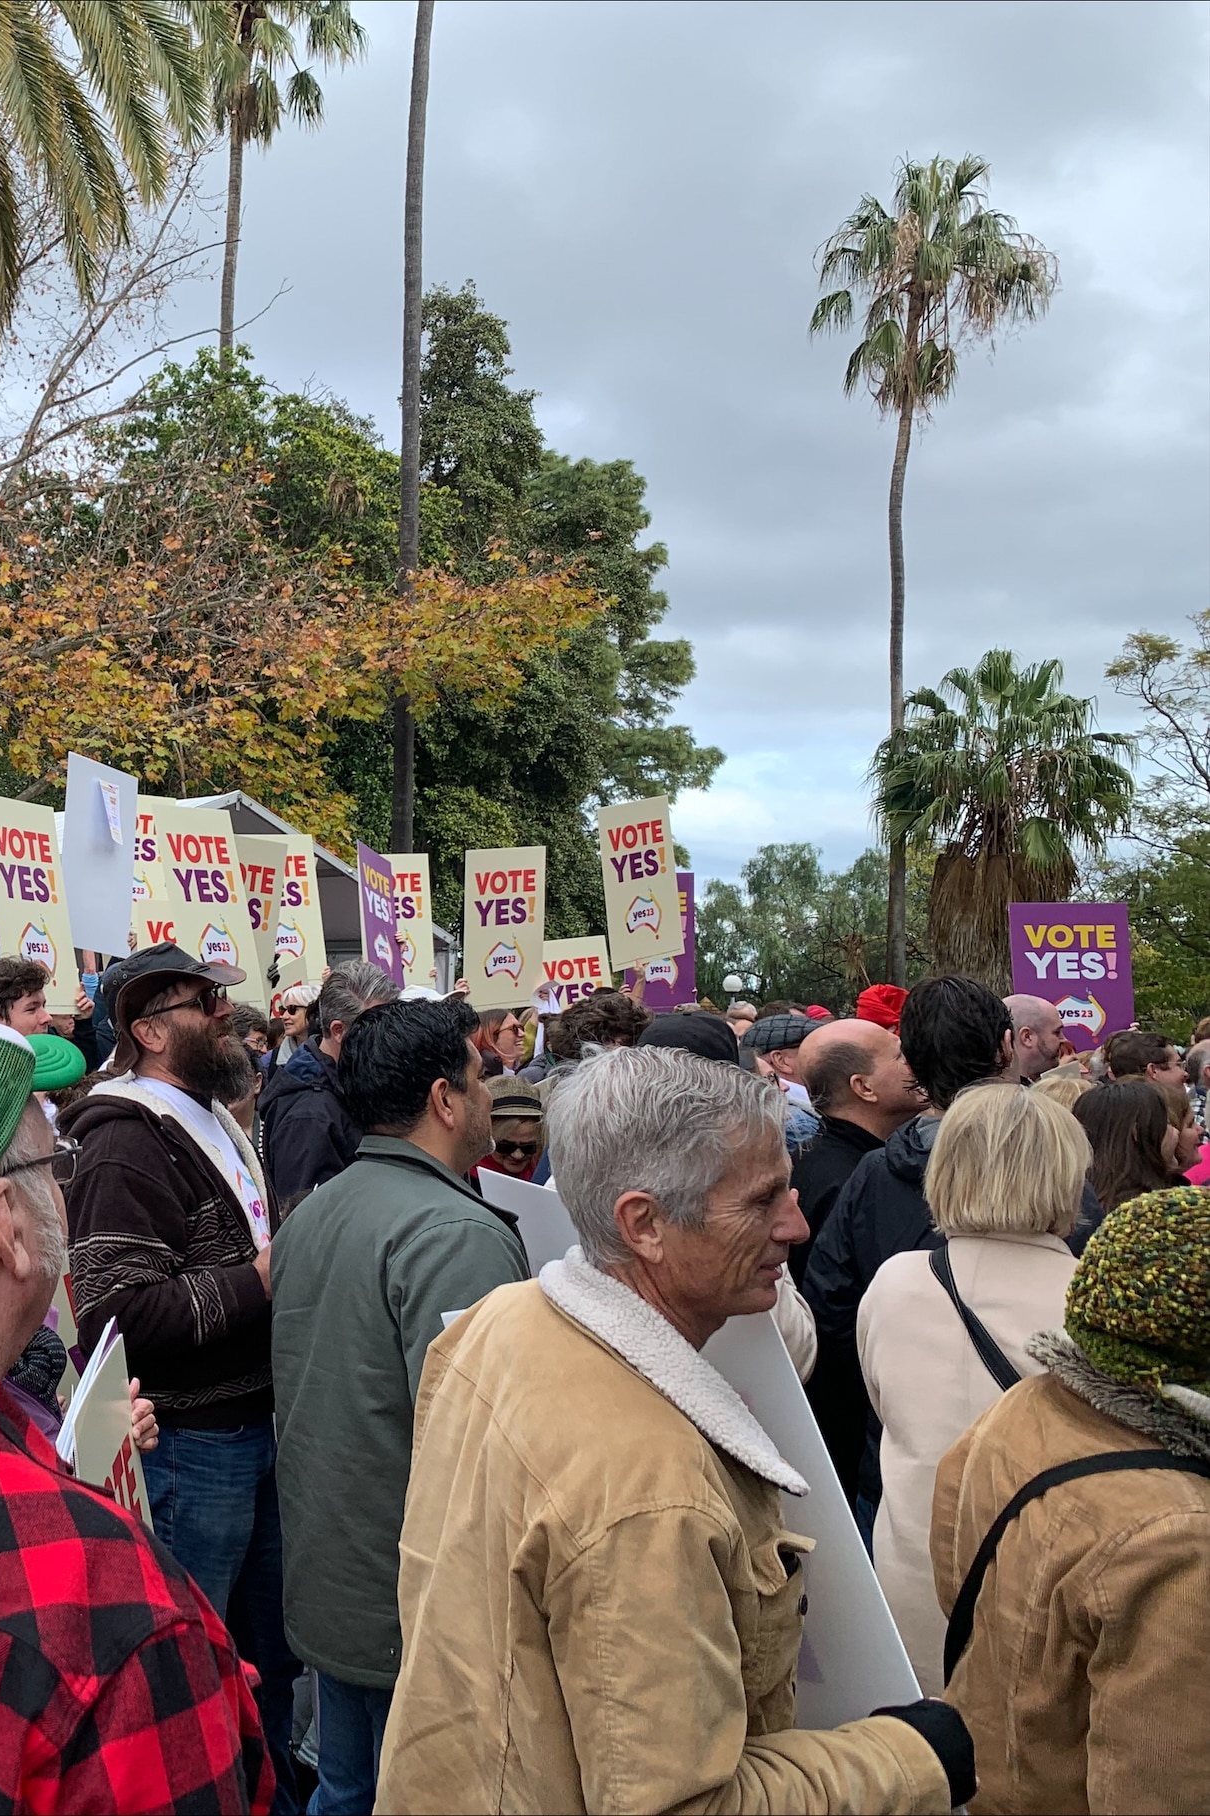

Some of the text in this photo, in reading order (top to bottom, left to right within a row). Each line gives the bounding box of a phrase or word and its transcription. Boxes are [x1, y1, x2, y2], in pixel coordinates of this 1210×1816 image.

[607, 819, 664, 851] VOTE
[166, 833, 230, 865] VOTE
[284, 855, 308, 877] TE
[610, 847, 667, 883] YES!
[132, 887, 145, 895] s23
[172, 869, 238, 904] YES!
[239, 862, 276, 895] TE
[362, 862, 391, 899] VOTE
[391, 873, 422, 892] TE
[474, 869, 536, 896] VOTE
[280, 881, 311, 907] S!
[364, 886, 394, 925] YES!
[247, 898, 272, 932] S!
[394, 896, 423, 919] S!
[474, 896, 536, 927] YES!
[632, 907, 654, 922] yes23
[146, 920, 177, 944] VO
[275, 936, 298, 946] yes23
[1024, 924, 1117, 949] VOTE
[26, 940, 49, 954] yes23
[206, 941, 231, 955] yes23
[492, 955, 516, 967] yes23
[542, 956, 602, 981] VOTE
[649, 963, 671, 974] yes23
[1024, 951, 1118, 980] YES!
[1058, 1009, 1093, 1019] yes23
